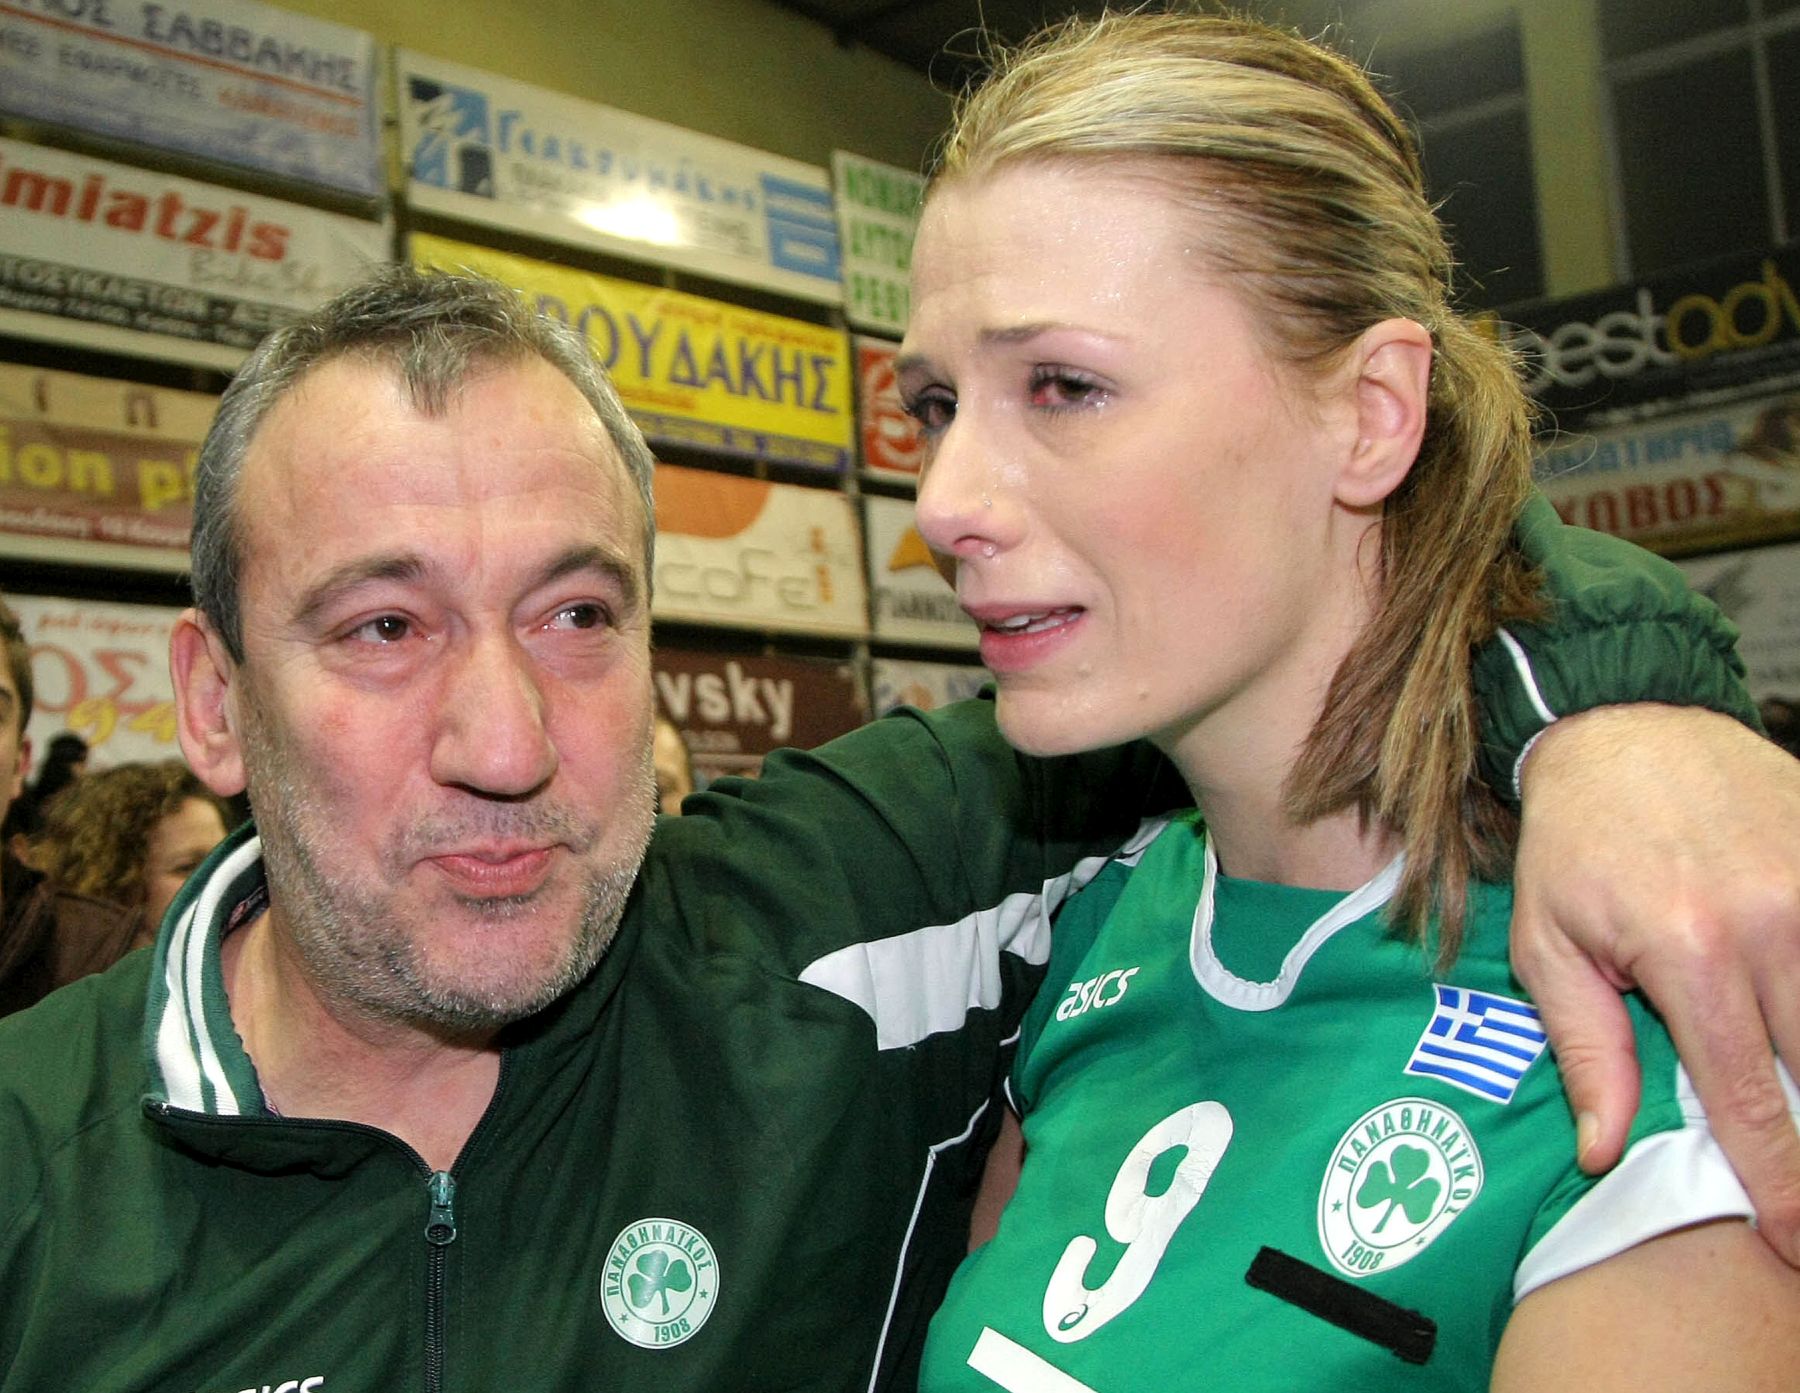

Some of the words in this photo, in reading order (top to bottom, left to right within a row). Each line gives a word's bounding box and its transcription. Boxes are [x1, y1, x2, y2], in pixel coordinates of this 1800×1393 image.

[142, 1, 361, 92] ΣΑΒΒΑΚΗΣ
[0, 150, 292, 263] miatzis
[654, 659, 796, 742] vsky
[1055, 966, 1141, 1022] asics
[1042, 1100, 1234, 1344] 9
[1340, 1239, 1386, 1271] 1908
[653, 1317, 692, 1342] 1908
